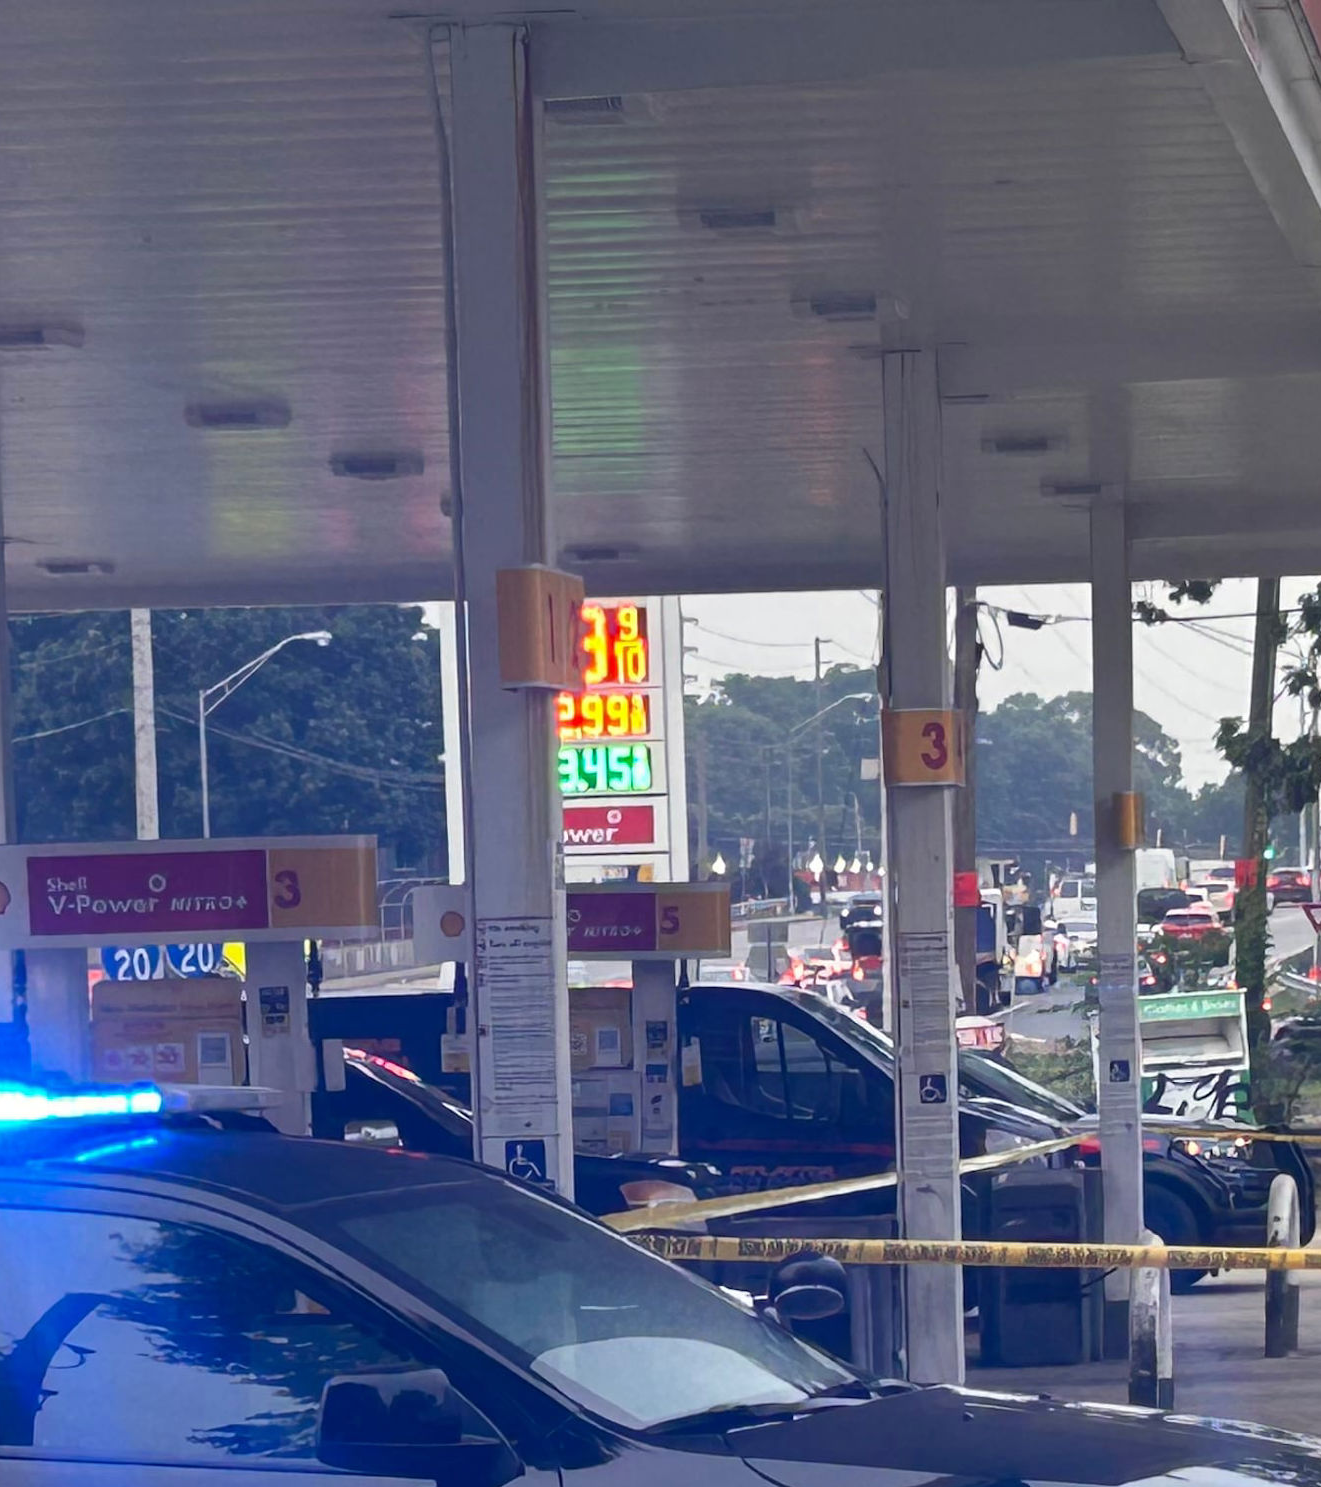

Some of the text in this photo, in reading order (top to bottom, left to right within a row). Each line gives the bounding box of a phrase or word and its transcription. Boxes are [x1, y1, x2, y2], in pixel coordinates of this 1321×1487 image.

[920, 722, 948, 770] 3
[46, 876, 87, 893] Shell
[274, 870, 301, 909] 3
[48, 894, 159, 916] V-Power
[661, 906, 680, 935] 5
[114, 947, 151, 981] 20
[180, 943, 214, 973] 20
